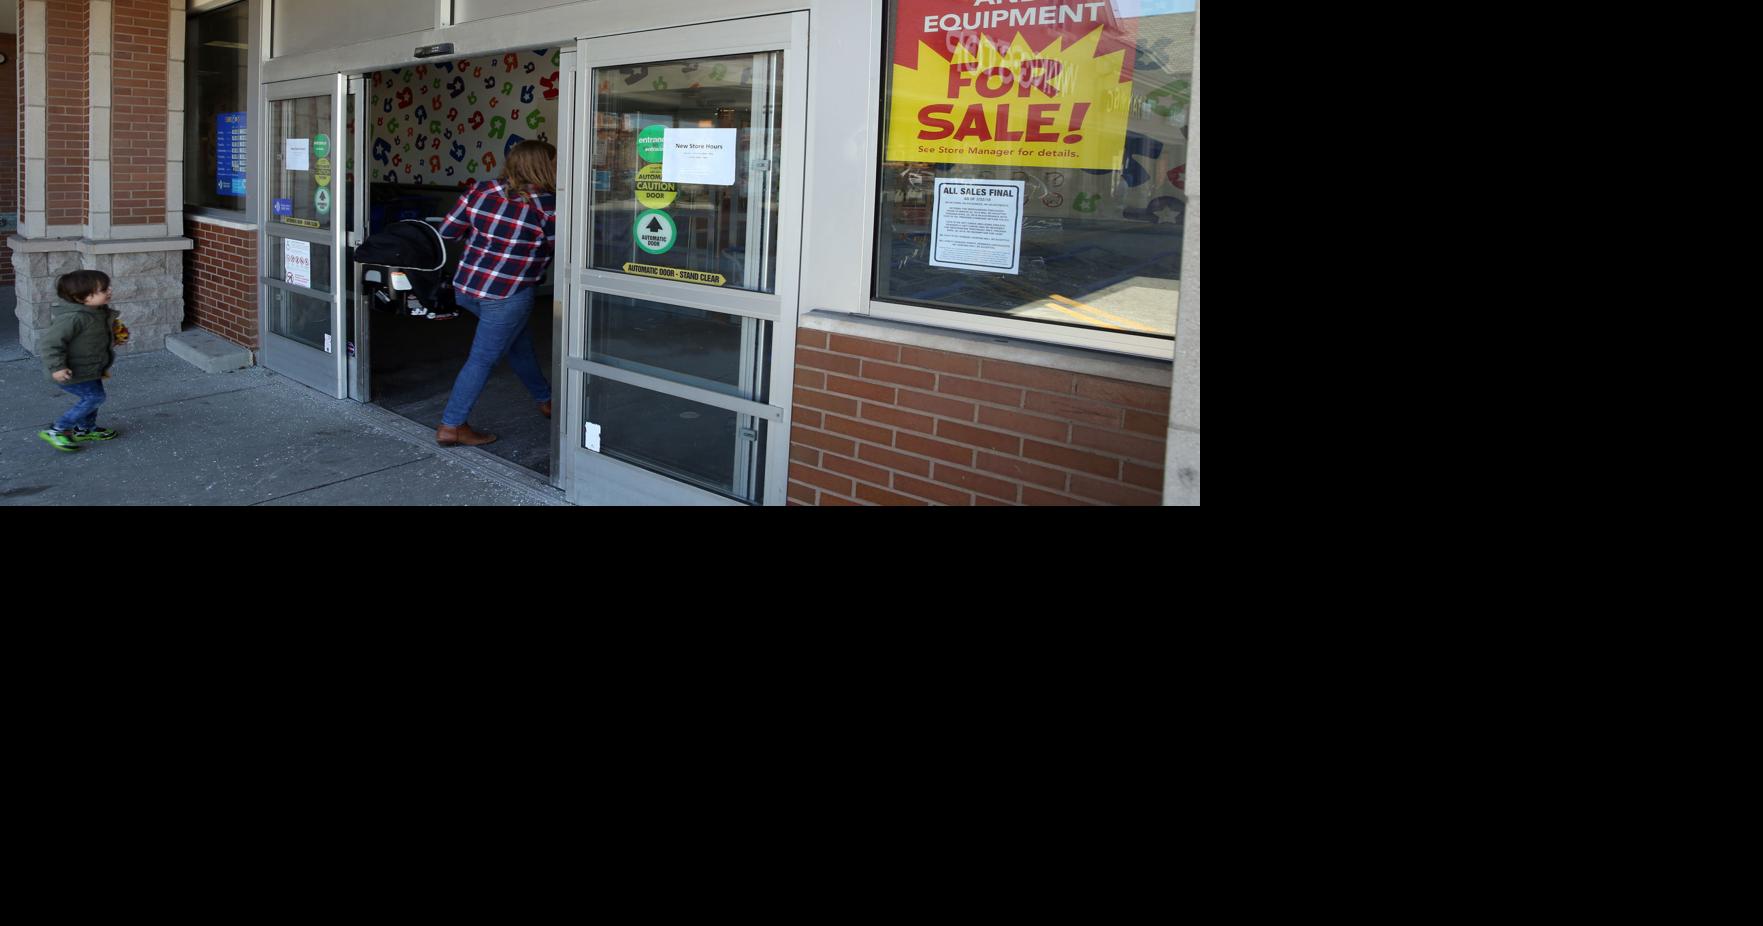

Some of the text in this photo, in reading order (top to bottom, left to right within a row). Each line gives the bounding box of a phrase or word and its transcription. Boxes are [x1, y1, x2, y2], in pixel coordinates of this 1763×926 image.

[924, 2, 1105, 33] EQUIPMENT
[947, 58, 1063, 99] FOR
[917, 102, 1091, 144] SALE!
[918, 145, 1080, 158] See Store Manager for details.
[636, 181, 675, 191] CAUTION
[943, 187, 1014, 197] ALL SALES FINAL
[628, 264, 658, 275] AUTOMATIC
[659, 269, 675, 278] DOOR
[679, 271, 699, 281] STAND
[700, 274, 720, 283] CLEAR
